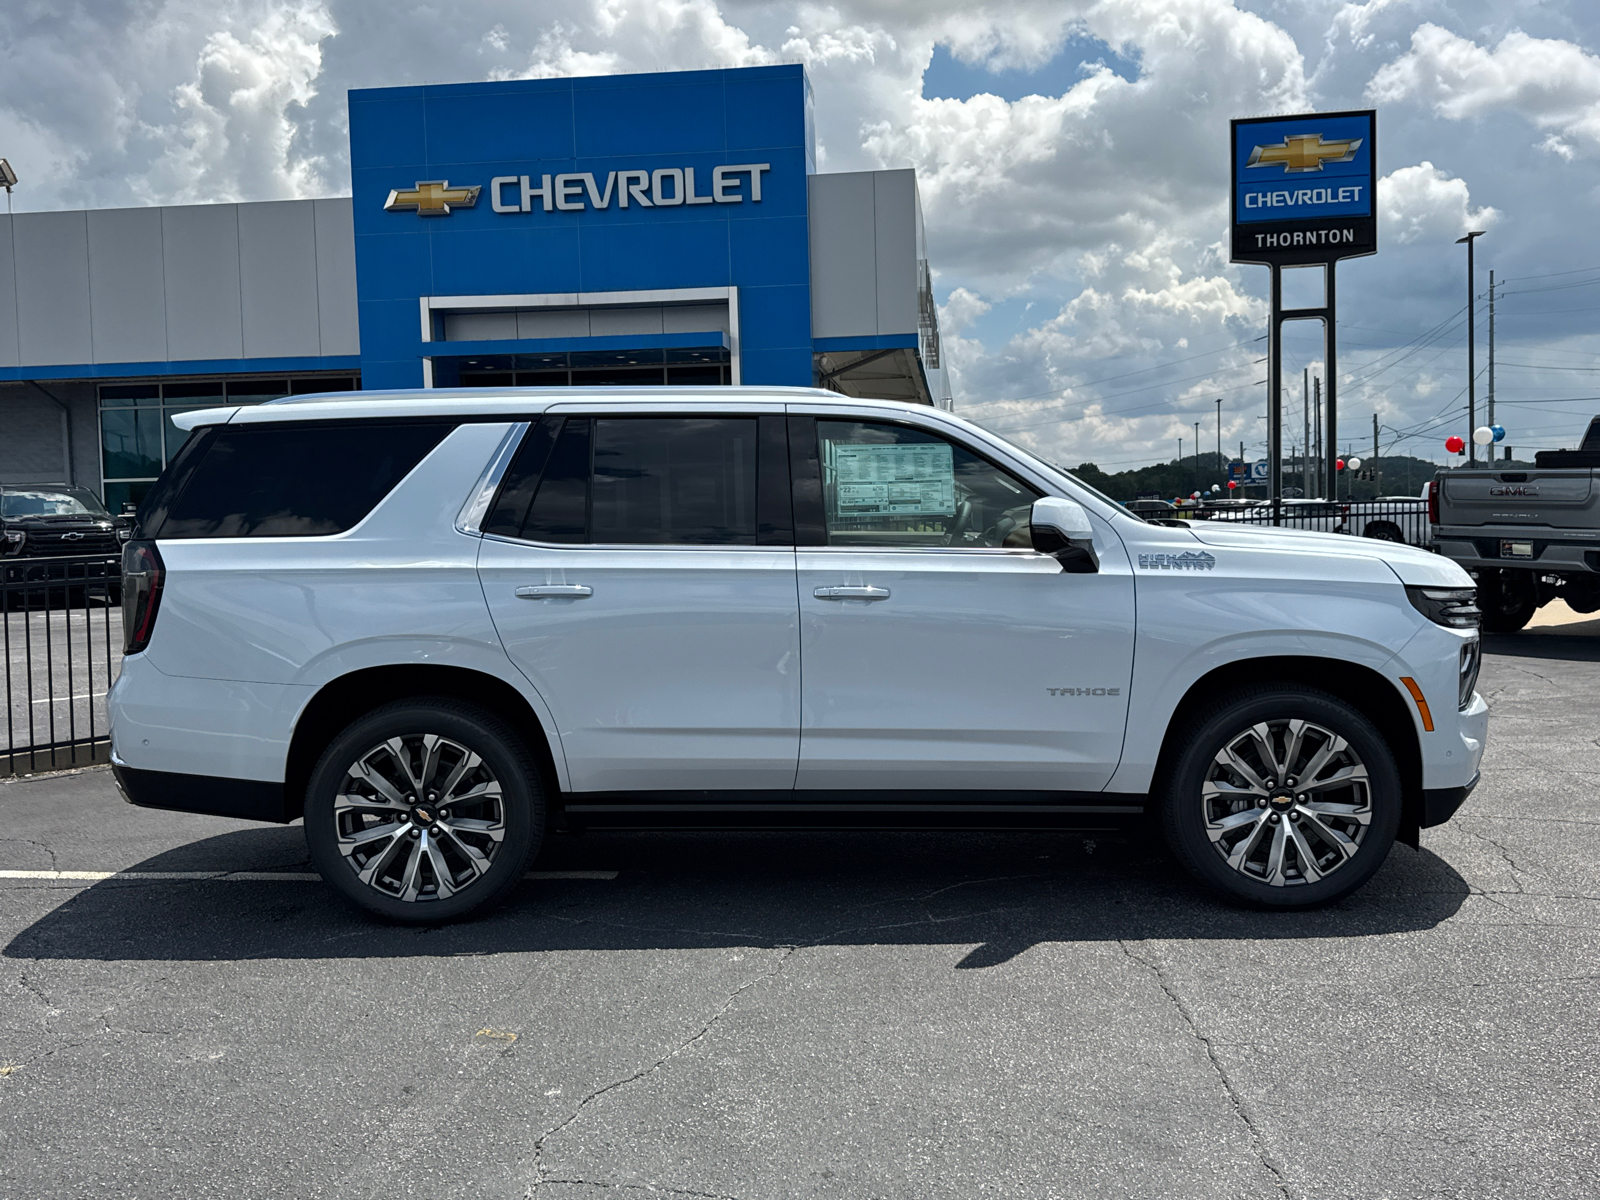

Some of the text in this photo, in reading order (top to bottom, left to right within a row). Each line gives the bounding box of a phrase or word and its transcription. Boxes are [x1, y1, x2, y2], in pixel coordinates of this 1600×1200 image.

[490, 163, 770, 213] CHEVROLET
[1244, 186, 1363, 208] CHEVROLET
[1255, 228, 1354, 248] THORNTON
[1489, 486, 1539, 497] GMC
[1138, 553, 1177, 561] HIGH
[1139, 560, 1215, 570] COUNTRY
[1046, 687, 1120, 696] TAHOE
